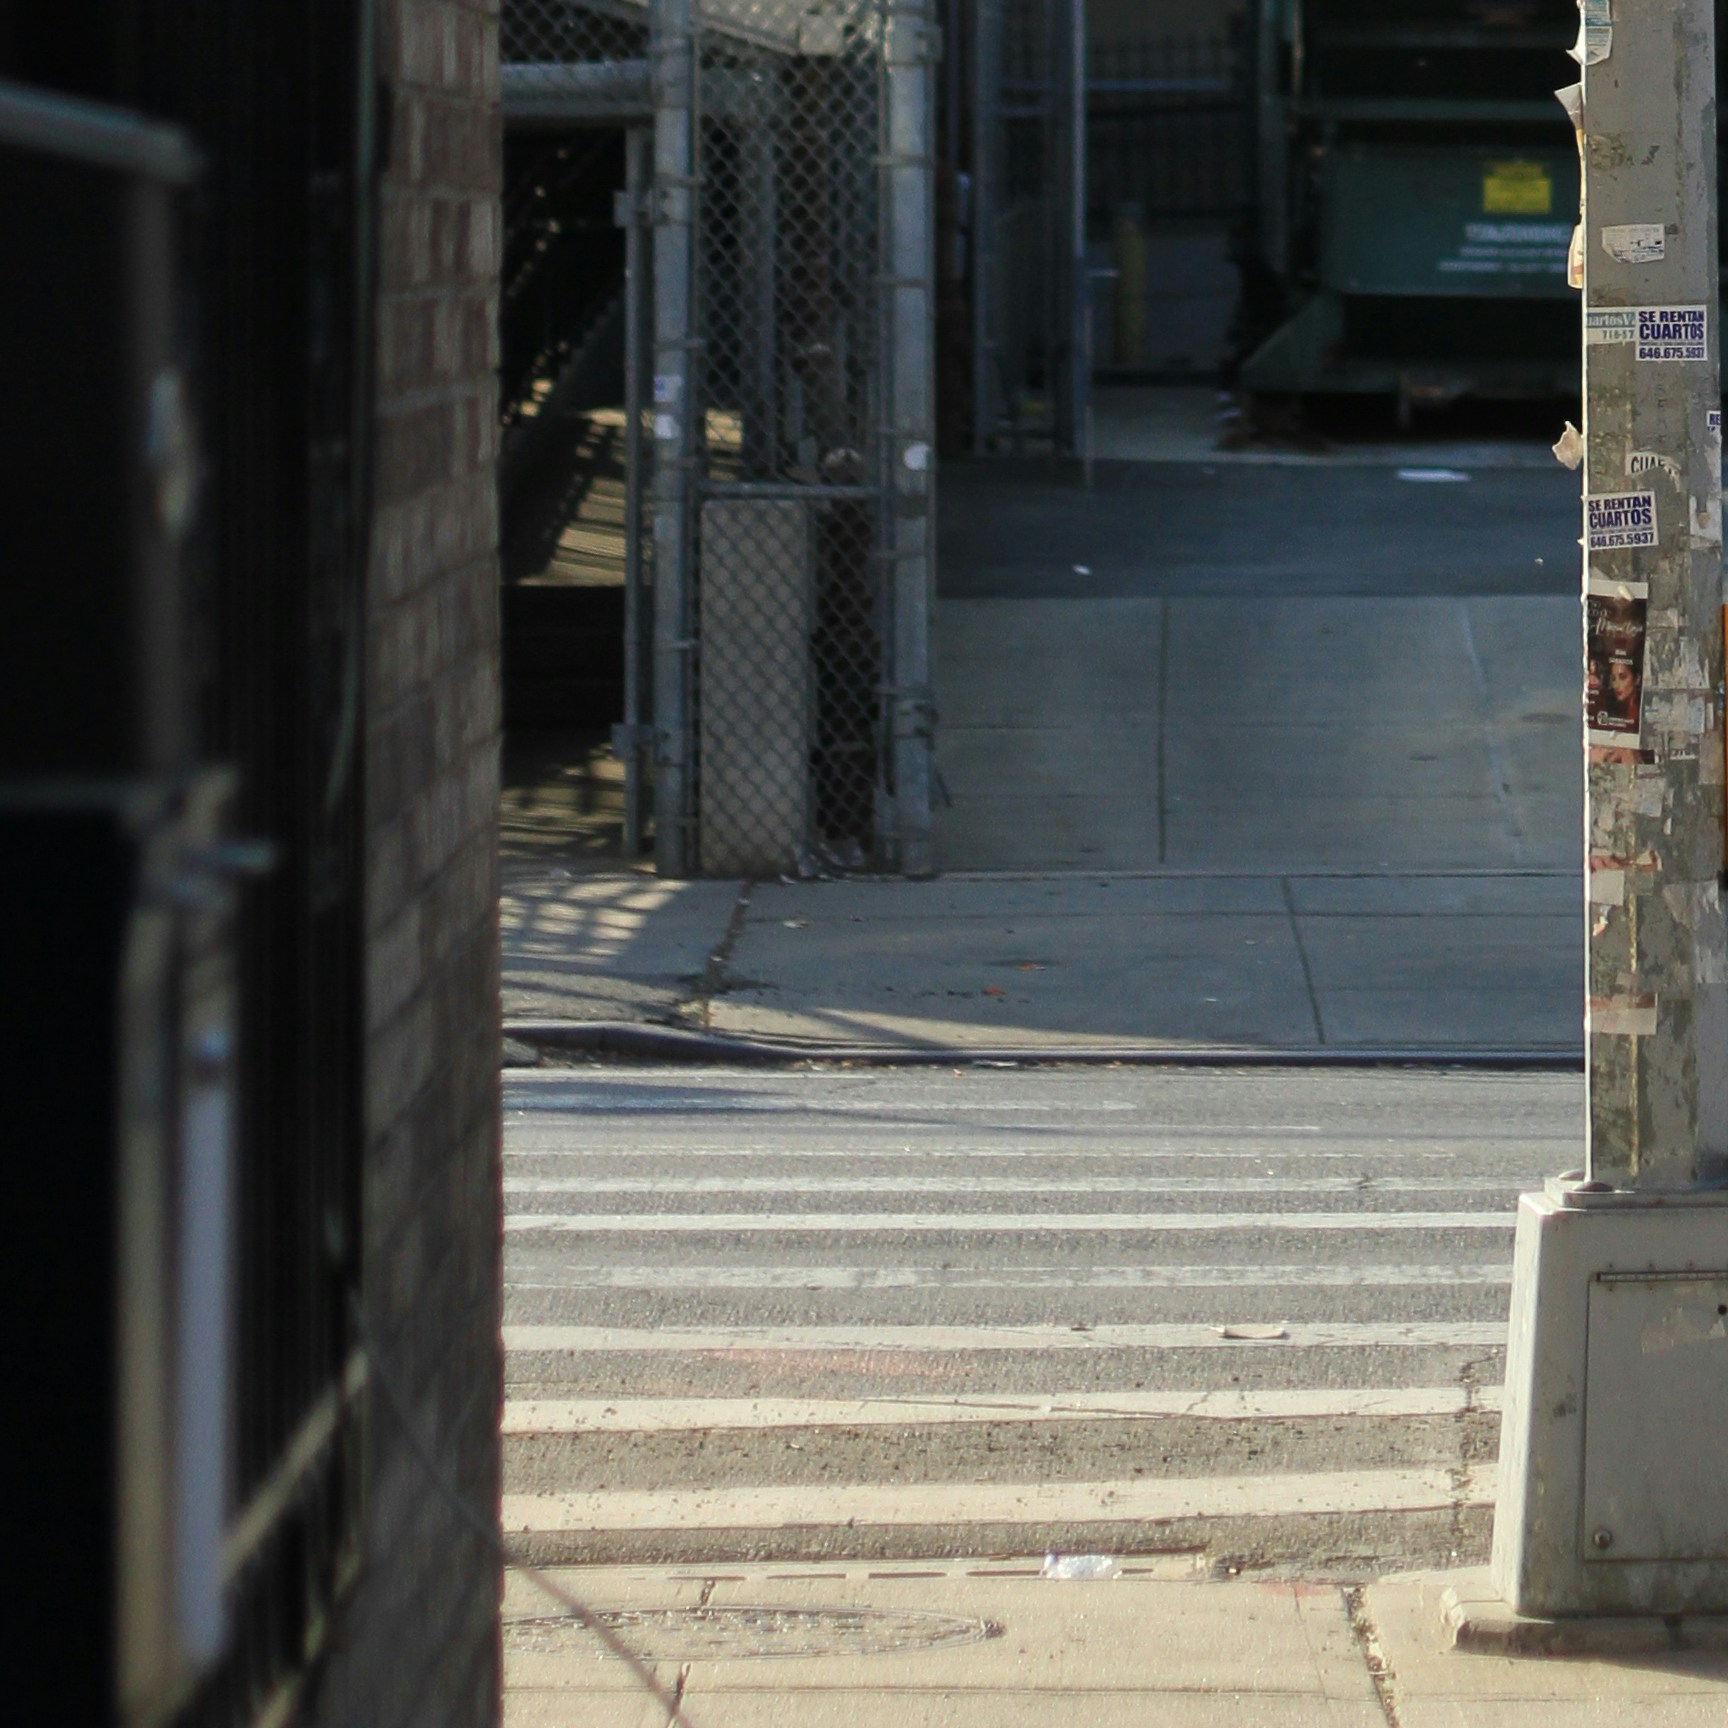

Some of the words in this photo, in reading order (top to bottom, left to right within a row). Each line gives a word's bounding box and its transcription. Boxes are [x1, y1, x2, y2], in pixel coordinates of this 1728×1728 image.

[1639, 311, 1656, 323] SE
[1660, 311, 1704, 323] RENTAN
[1640, 324, 1704, 340] CUARTOS
[1589, 500, 1601, 512] SE
[1604, 495, 1652, 511] RENTAN
[1590, 508, 1652, 529] CUARTOS
[1590, 532, 1654, 548] 646.675.5937
